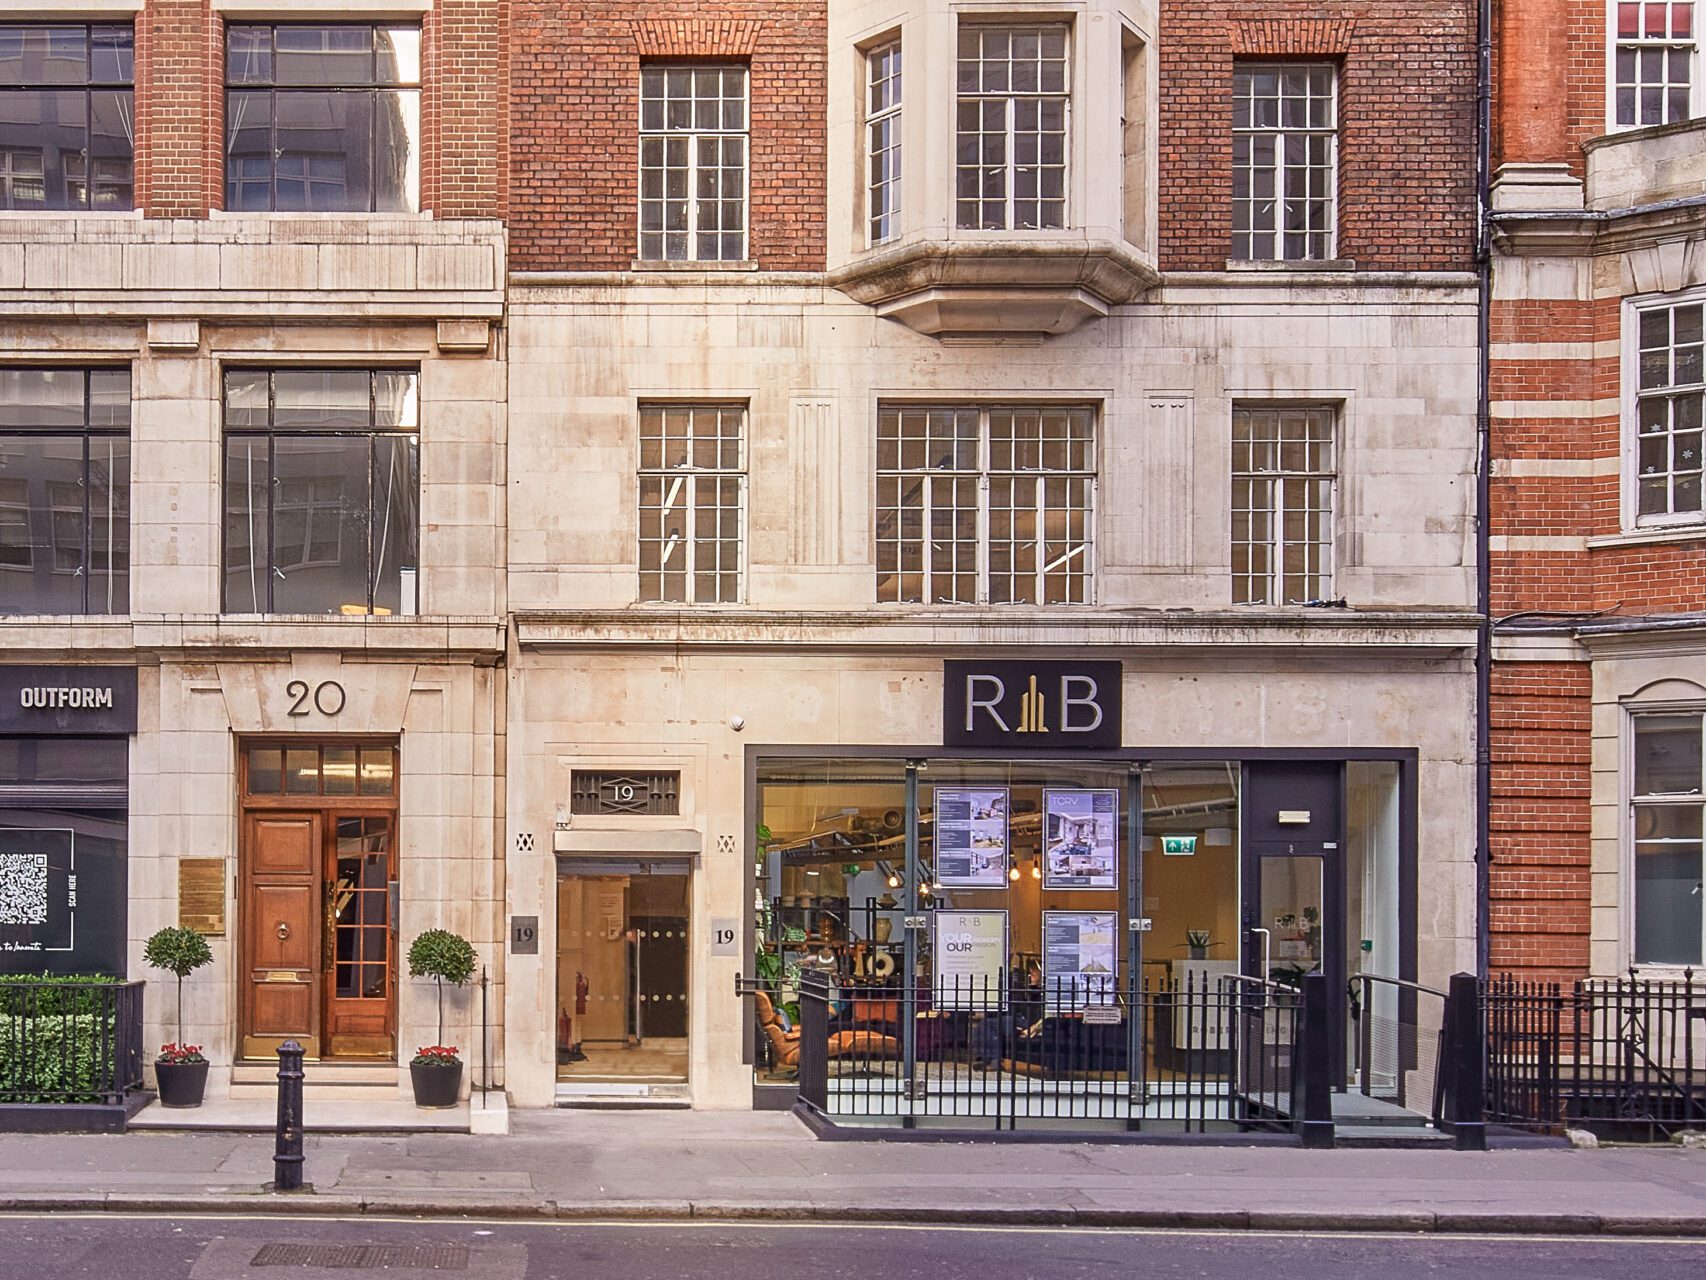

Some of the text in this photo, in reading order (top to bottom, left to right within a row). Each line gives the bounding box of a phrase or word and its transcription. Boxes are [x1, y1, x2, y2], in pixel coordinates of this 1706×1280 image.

[20, 687, 113, 708] OUTFORM
[286, 680, 346, 716] 20
[614, 785, 634, 801] 19
[68, 874, 77, 907] SCAN HERE
[514, 927, 534, 943] 19
[715, 929, 735, 945] 19
[946, 942, 972, 952] OUR
